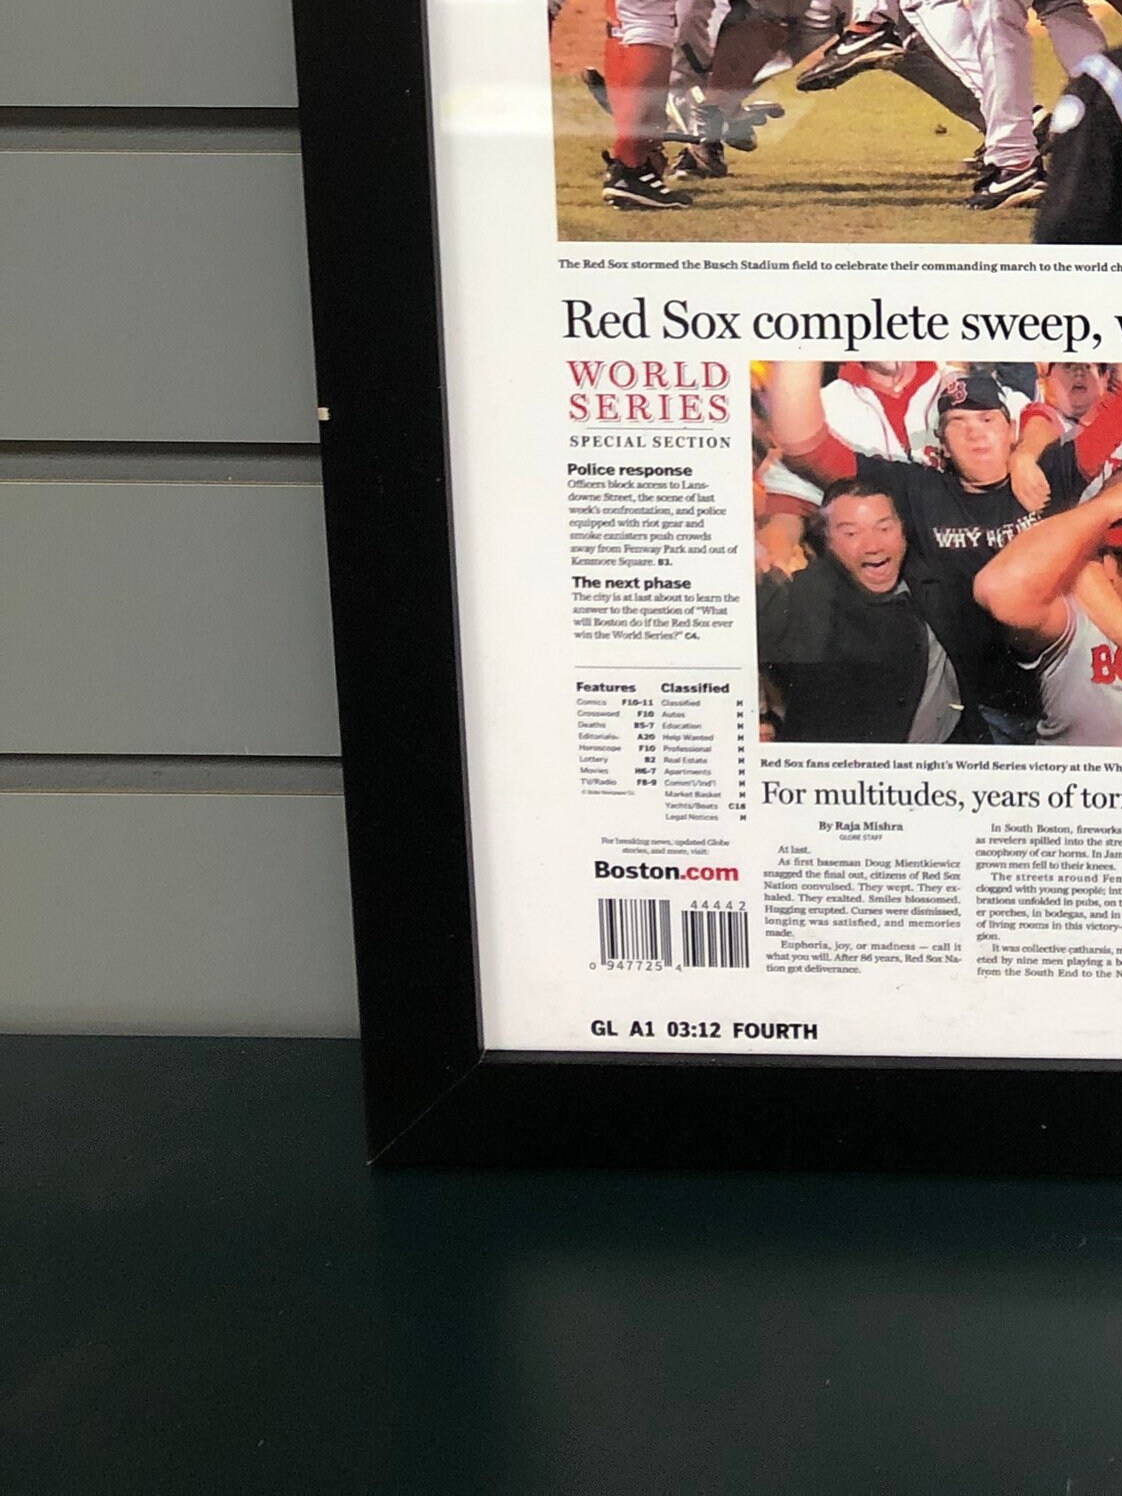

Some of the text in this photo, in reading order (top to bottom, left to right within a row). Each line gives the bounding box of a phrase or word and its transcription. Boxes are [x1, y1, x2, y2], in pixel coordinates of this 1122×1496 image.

[558, 259, 580, 268] The
[583, 259, 605, 268] Red
[607, 259, 628, 268] Sox
[631, 260, 678, 268] stormed
[682, 260, 700, 269] the
[703, 260, 738, 269] Busch
[741, 260, 789, 269] Stadium
[792, 260, 817, 269] field
[835, 261, 887, 270] celebrate
[890, 261, 919, 270] their
[921, 262, 997, 272] commanding
[1000, 262, 1036, 271] march
[1039, 263, 1050, 271] to
[1053, 263, 1071, 271] the
[1074, 263, 1107, 271] world
[562, 297, 649, 338] Red
[663, 300, 740, 339] Sox
[753, 298, 948, 351] complete
[962, 314, 1101, 352] sweep,
[566, 360, 729, 389] WORLD
[569, 393, 728, 422] SERIES
[570, 435, 730, 447] SPECIAL SECTION
[567, 463, 692, 477] Police response
[933, 527, 982, 548] WHY
[571, 576, 690, 590] The next phase
[576, 682, 636, 692] Features
[661, 683, 729, 693] Classified
[760, 758, 781, 767] Red
[784, 759, 803, 767] Sox
[806, 759, 829, 767] fans
[832, 759, 889, 768] celebrated
[893, 760, 912, 768] last
[916, 760, 952, 770] night's
[956, 761, 989, 769] World
[992, 761, 1026, 770] Series
[1029, 762, 1067, 773] victory
[1070, 763, 1080, 771] at
[1083, 762, 1100, 771] the
[762, 781, 806, 804] For
[814, 780, 963, 810] multitudes,
[972, 790, 1039, 813] years
[1048, 783, 1076, 808] of
[819, 821, 903, 831] By Raja Mishra
[595, 861, 738, 880] Boston.com
[690, 899, 746, 911] 44442
[606, 960, 664, 972] 947725
[591, 1020, 817, 1039] GL A1 03:12 FOURTH
